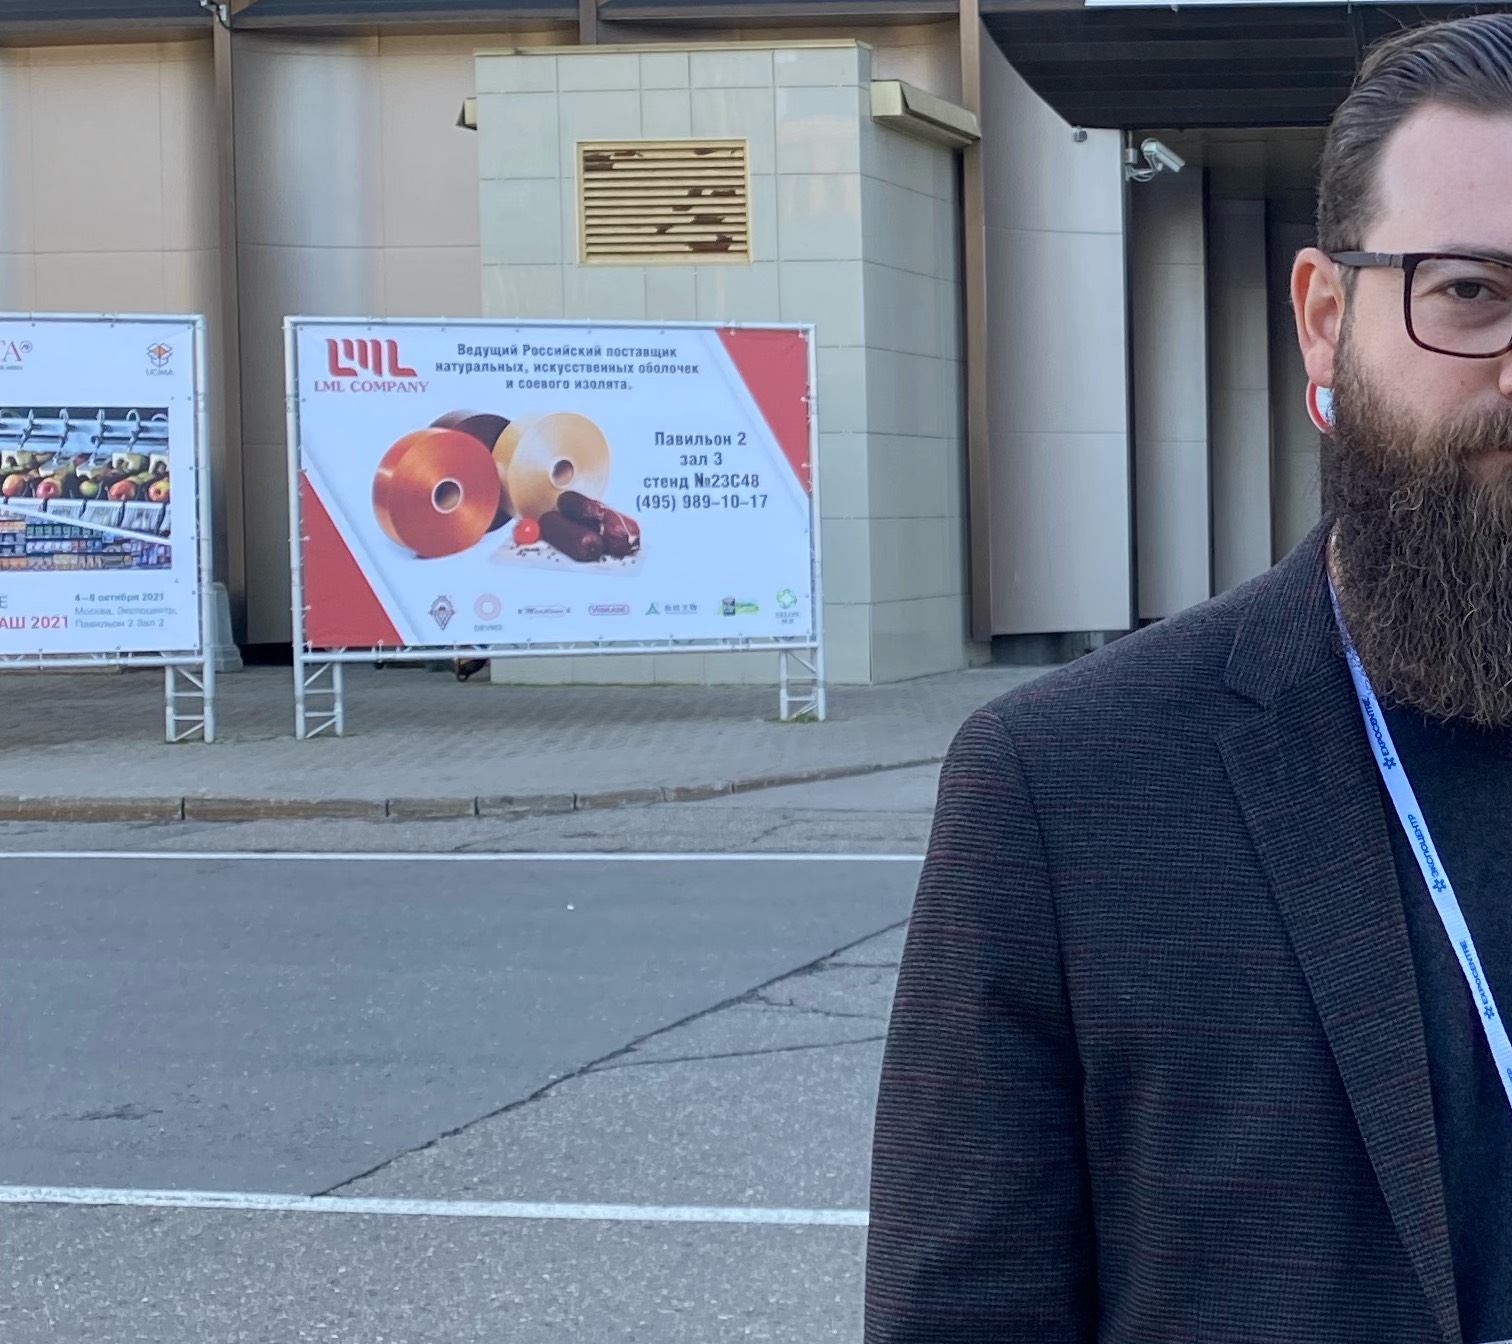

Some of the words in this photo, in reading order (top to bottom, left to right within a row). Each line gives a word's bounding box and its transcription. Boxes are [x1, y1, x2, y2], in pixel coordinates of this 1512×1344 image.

[457, 343, 518, 358] Ведущий
[522, 344, 601, 356] Российский
[606, 346, 677, 358] поставщик
[435, 362, 529, 374] натуральных,
[533, 363, 634, 374] искусственных
[638, 362, 699, 374] оболочек
[314, 381, 345, 393] LML
[350, 381, 429, 393] COMPANY
[506, 380, 513, 390] и
[518, 380, 569, 390] соевого
[574, 380, 633, 390] изолята.
[654, 431, 732, 446] Павильон
[737, 432, 747, 446] 2
[679, 454, 708, 466] зал
[713, 452, 723, 466] 3
[643, 476, 689, 490] стенд
[636, 494, 676, 513] (495)
[97, 593, 139, 603] октября
[142, 592, 164, 601] 2021
[31, 615, 69, 630] 2021
[127, 618, 134, 628] 2
[158, 618, 165, 628] 2
[1407, 814, 1439, 878] ЭКСПОЦЕНТР
[1459, 939, 1489, 1006] EXPOCENTRE
